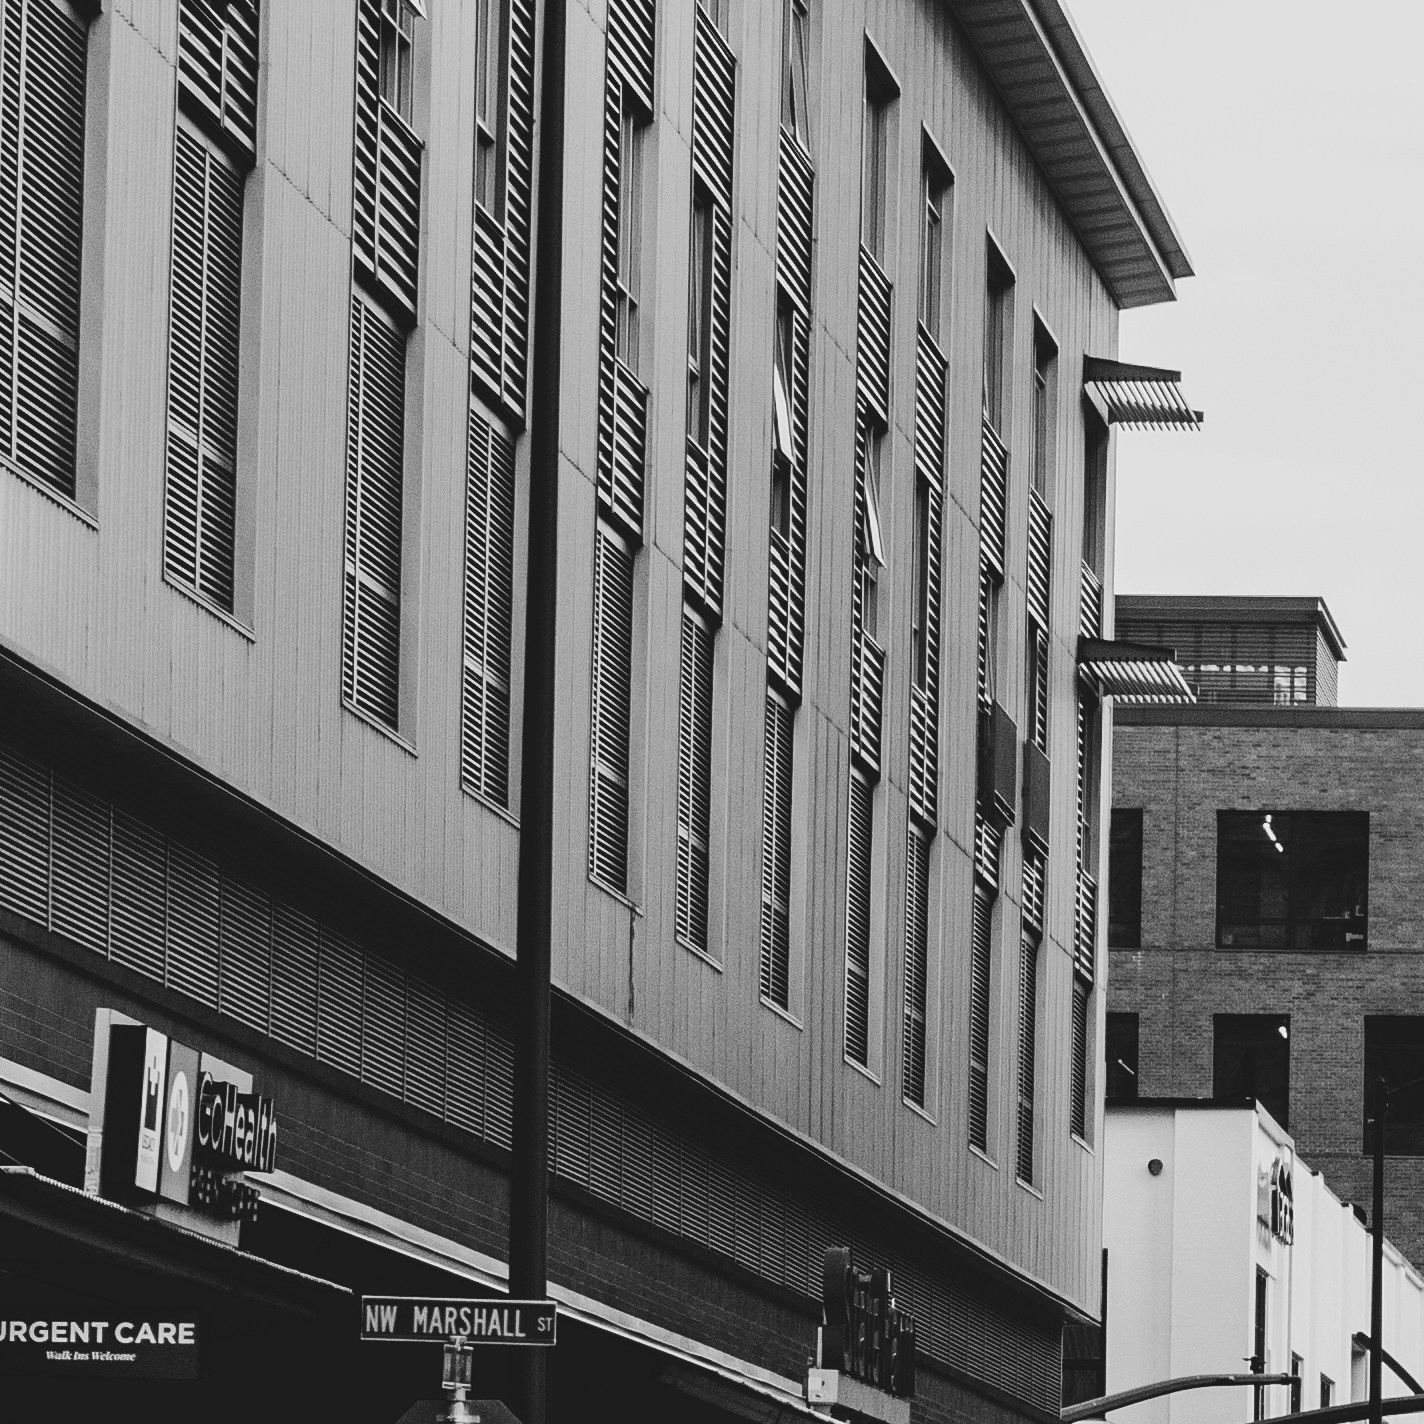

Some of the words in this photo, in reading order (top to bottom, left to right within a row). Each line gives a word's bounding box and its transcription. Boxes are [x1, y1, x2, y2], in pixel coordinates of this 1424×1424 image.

[199, 1071, 277, 1171] GoHealth
[114, 1321, 195, 1345] CARE
[366, 1305, 397, 1333] NW
[413, 1305, 526, 1337] MARSHALL
[537, 1317, 553, 1332] ST
[46, 1350, 72, 1360] Walk
[73, 1350, 90, 1361] Ins
[91, 1350, 137, 1362] Welcome
